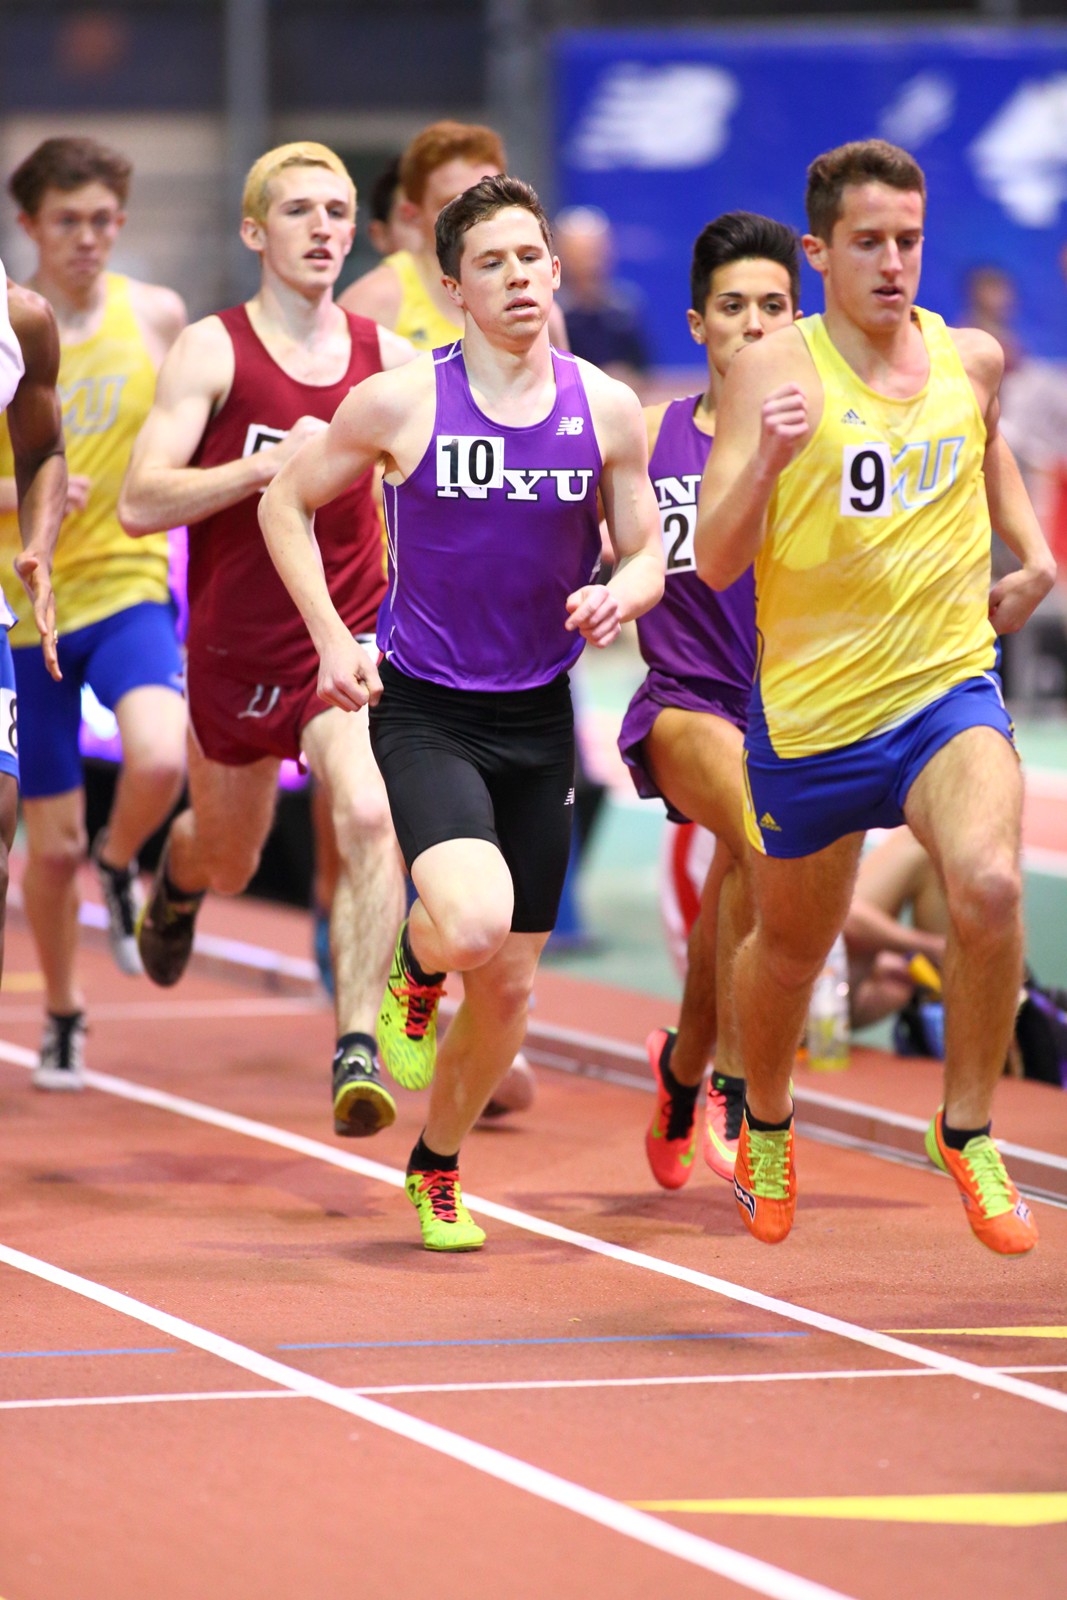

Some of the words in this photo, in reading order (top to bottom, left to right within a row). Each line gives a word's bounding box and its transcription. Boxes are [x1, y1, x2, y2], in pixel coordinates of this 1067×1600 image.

[441, 438, 494, 486] 10
[849, 449, 885, 513] 9
[663, 513, 692, 570] 2
